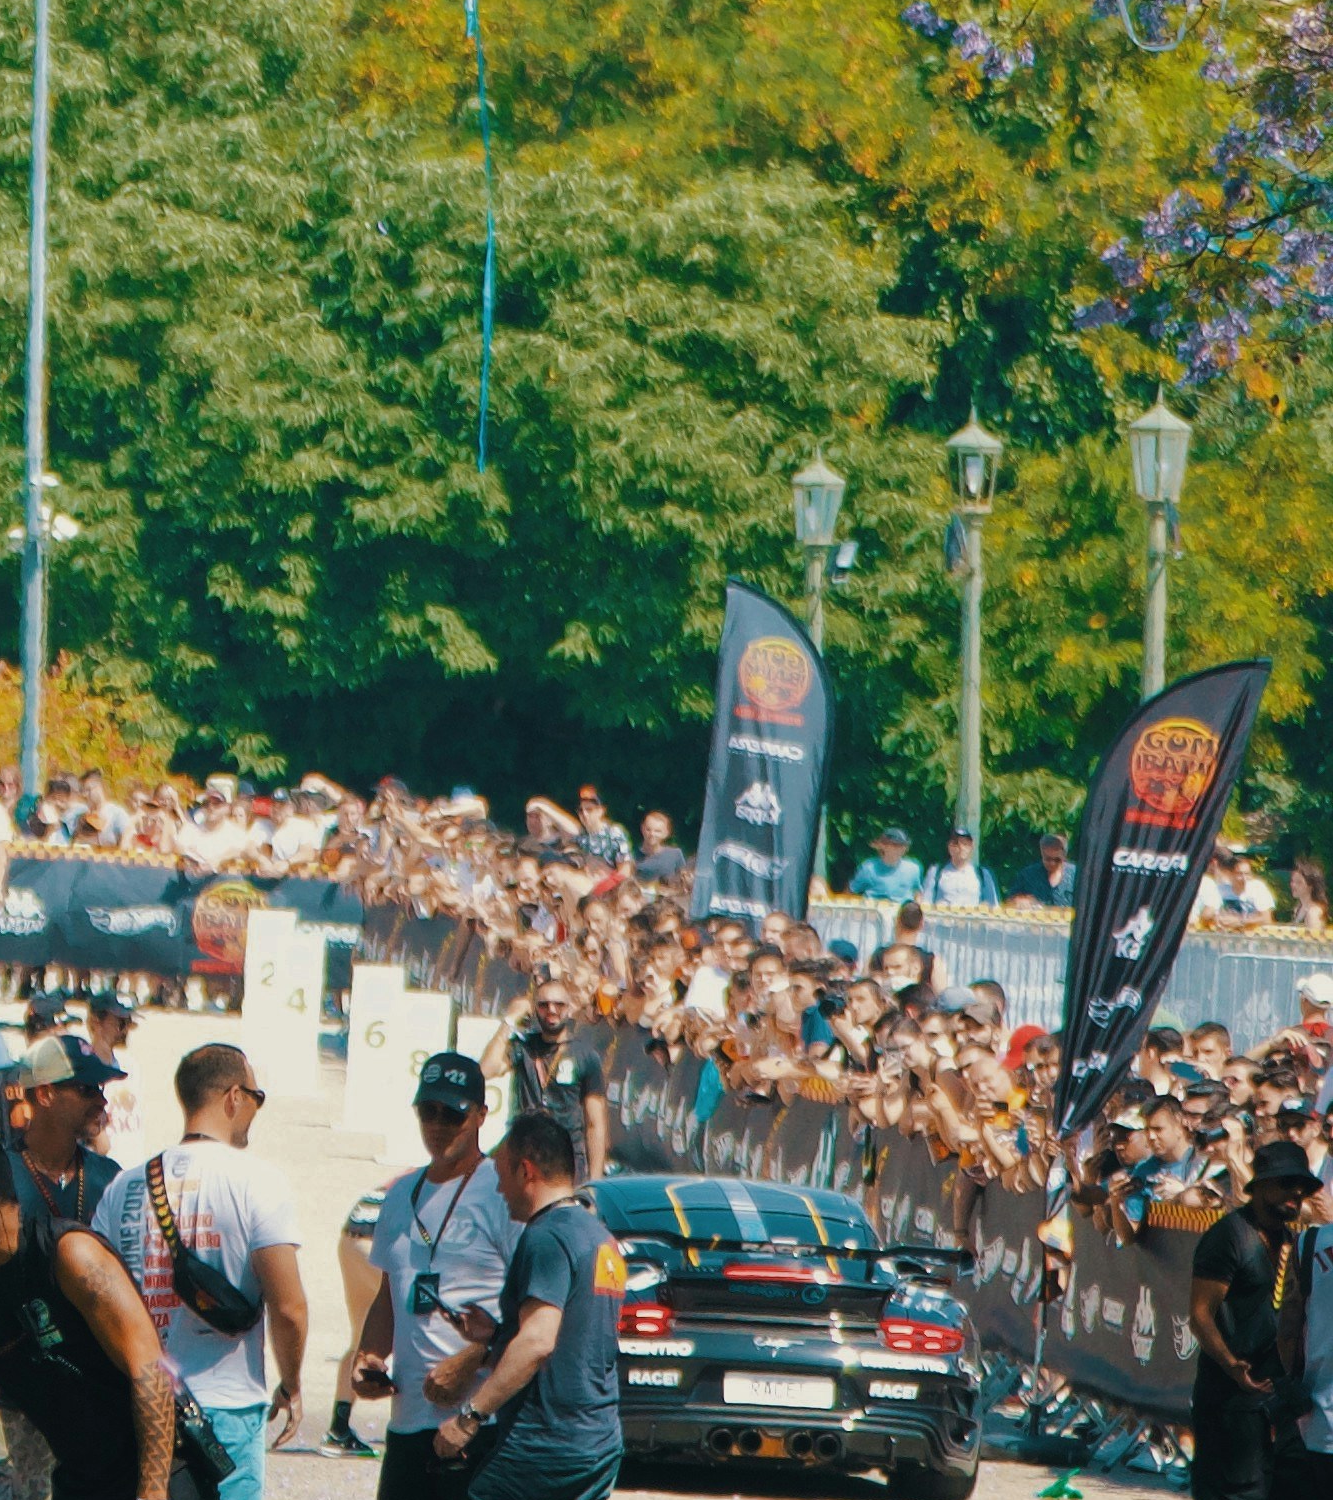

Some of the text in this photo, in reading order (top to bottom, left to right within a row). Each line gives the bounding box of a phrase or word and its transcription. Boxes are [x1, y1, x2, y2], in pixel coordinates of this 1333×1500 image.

[260, 961, 276, 987] 2
[286, 987, 307, 1014] 4
[364, 1020, 387, 1049] 6
